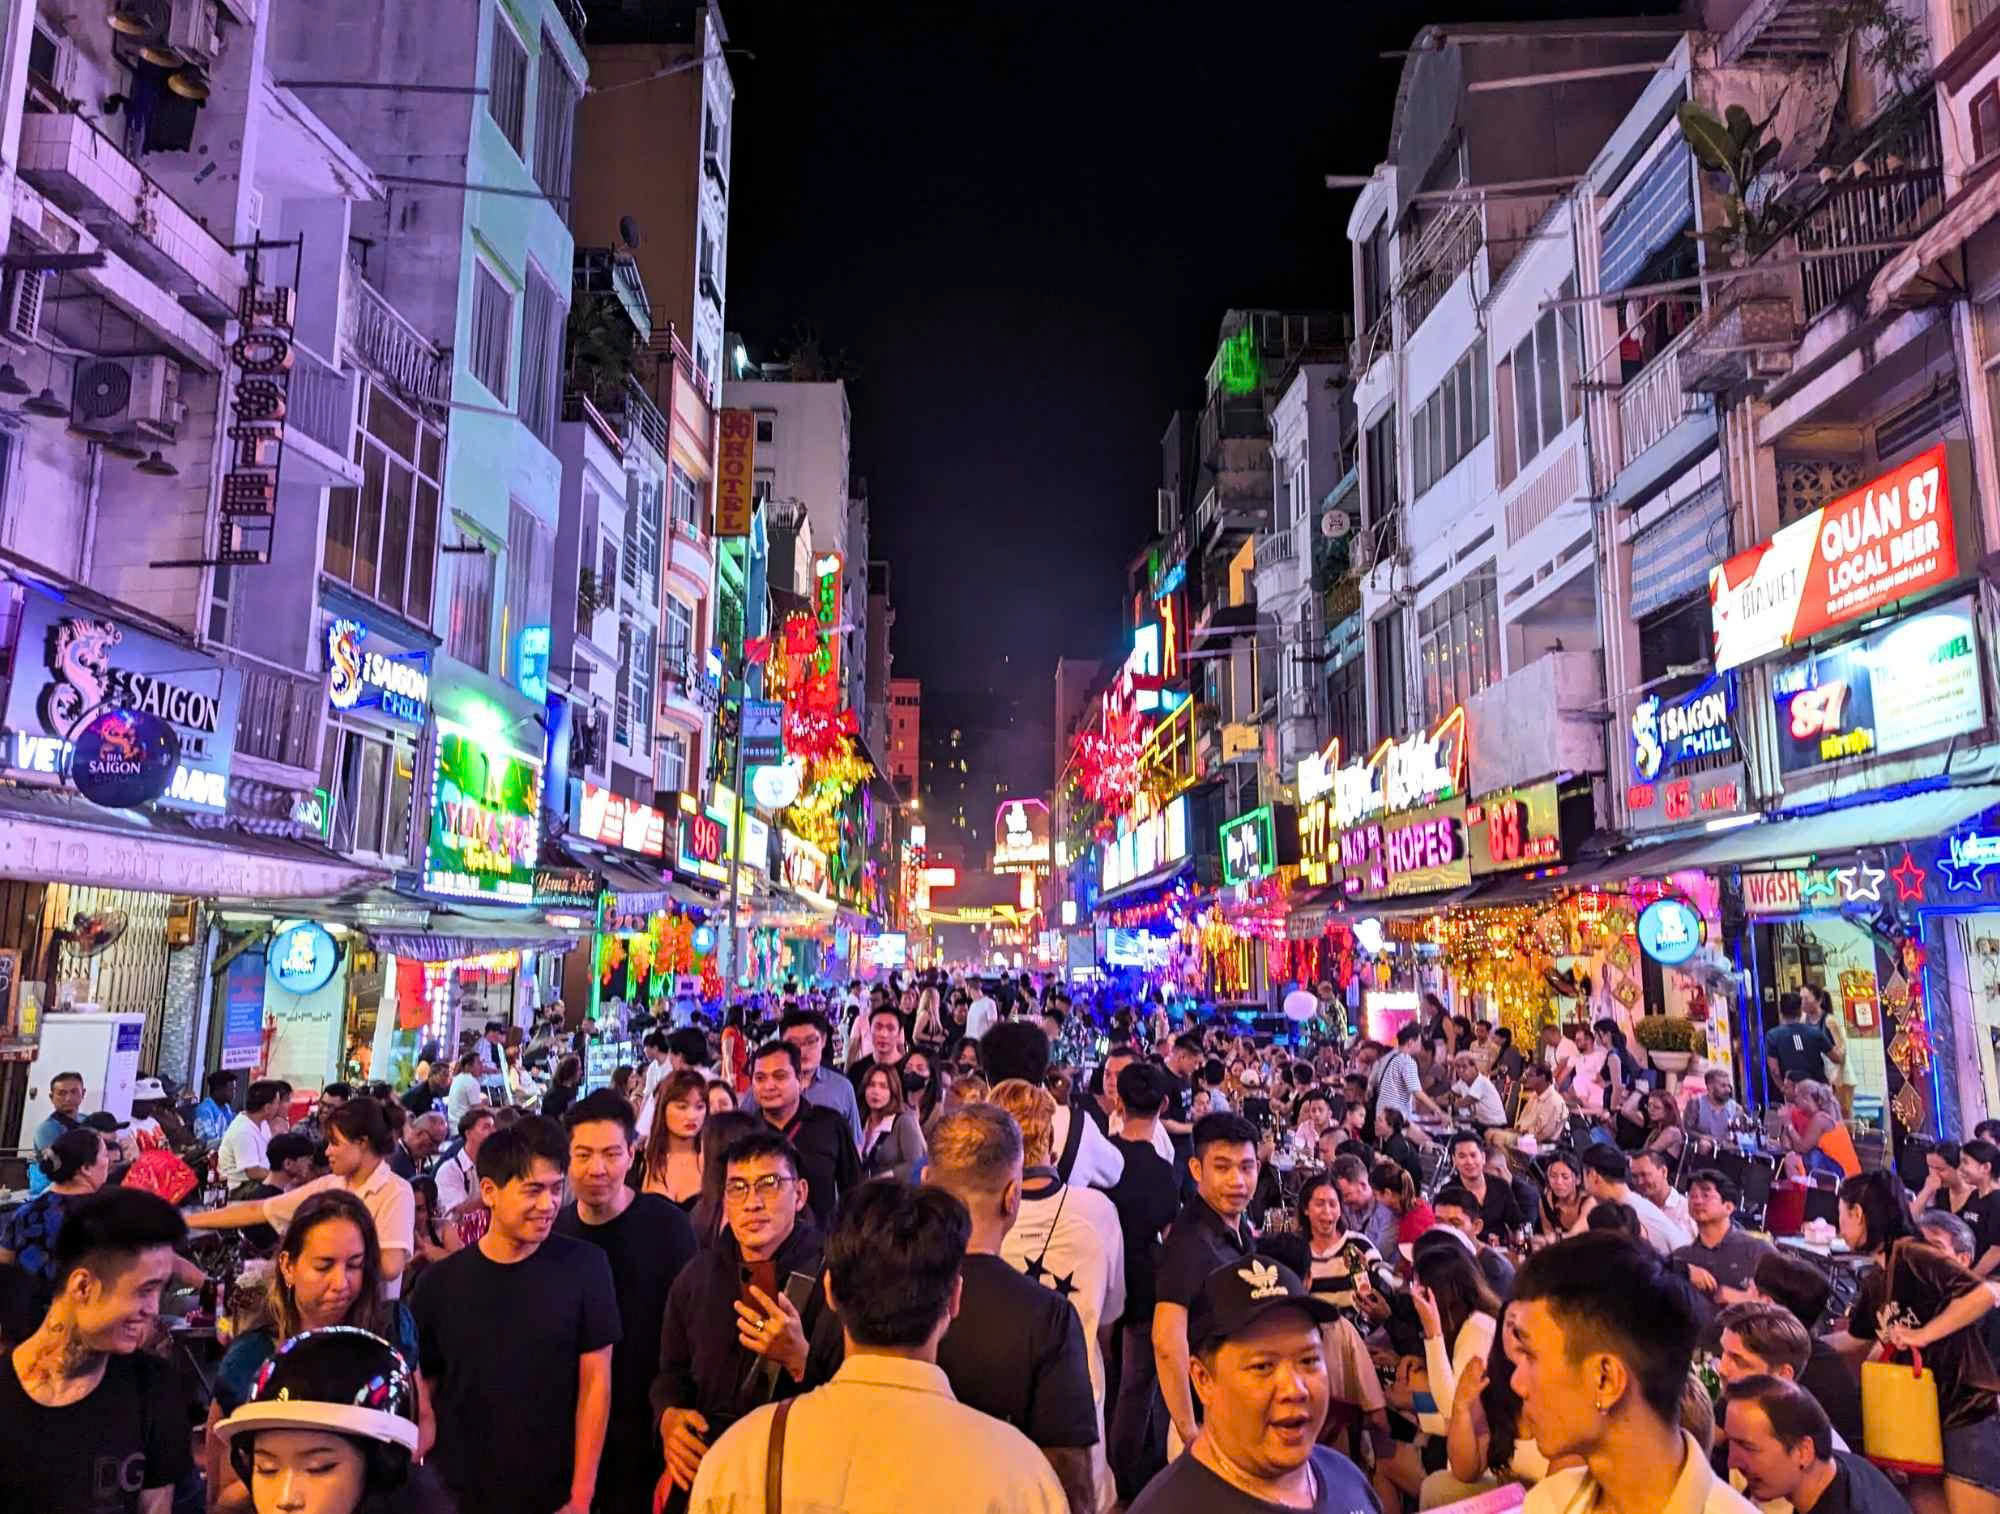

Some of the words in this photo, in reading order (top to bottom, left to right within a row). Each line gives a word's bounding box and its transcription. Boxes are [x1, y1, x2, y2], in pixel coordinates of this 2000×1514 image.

[221, 286, 296, 562] HOSTEL
[722, 441, 745, 530] HOTEL
[1821, 486, 1902, 562] QUÁN
[1908, 466, 1940, 521] 87
[1828, 549, 1888, 595] LOCAL
[1890, 520, 1940, 568] BEER
[1790, 679, 1849, 738] 87
[89, 760, 141, 774] SAIGON
[1682, 726, 1732, 755] CHILL
[694, 815, 718, 862] 96
[1386, 816, 1456, 872] HOPES
[1749, 870, 1801, 904] WASH
